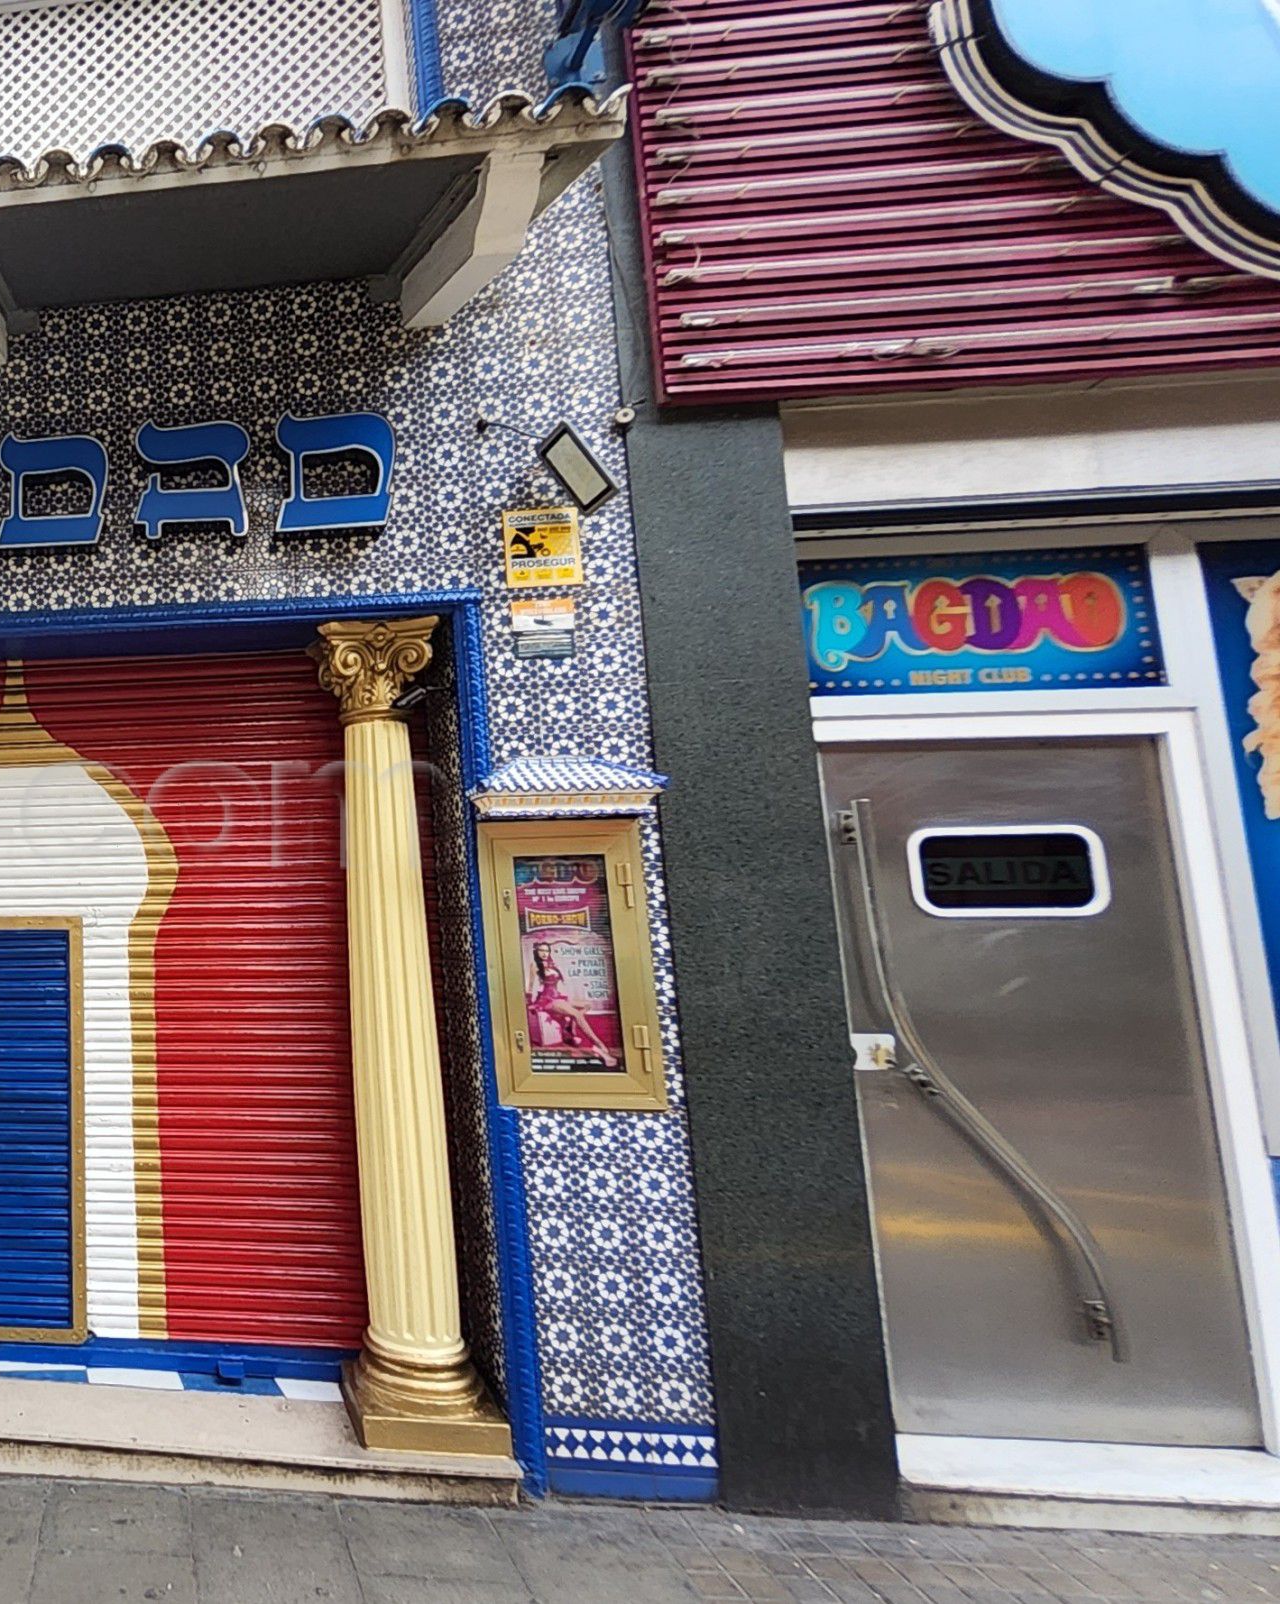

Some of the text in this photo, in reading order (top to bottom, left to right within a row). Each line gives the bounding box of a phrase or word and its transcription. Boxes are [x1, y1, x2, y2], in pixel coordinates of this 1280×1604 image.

[511, 556, 576, 570] PROSEGUR
[909, 667, 1032, 686] NIGHT CLUB
[928, 861, 1080, 886] SALIDA
